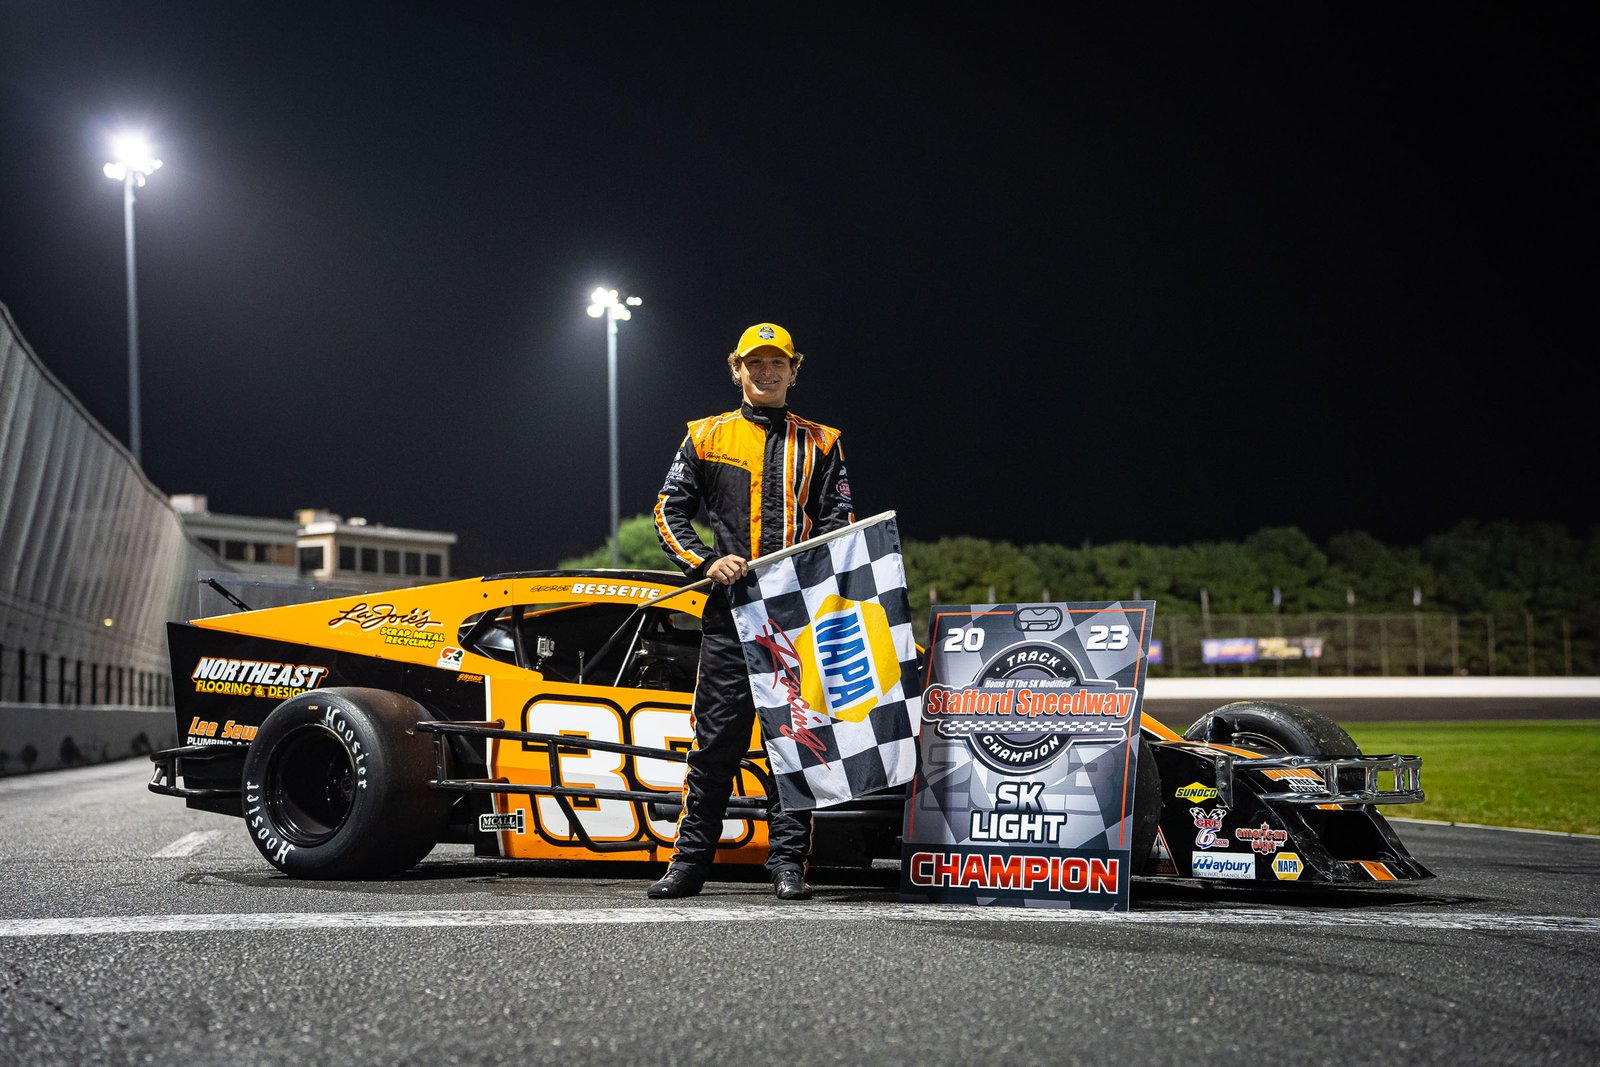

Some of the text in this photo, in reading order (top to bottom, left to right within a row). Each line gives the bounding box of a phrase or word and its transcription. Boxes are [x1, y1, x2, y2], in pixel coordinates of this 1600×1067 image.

[571, 583, 661, 600] BESSETTE
[380, 627, 412, 638] SCRAP
[413, 630, 446, 643] METAL
[384, 636, 436, 649] RECYCLING
[943, 627, 986, 652] 20
[1086, 624, 1130, 651] 23
[815, 612, 875, 709] NAPA
[1006, 650, 1062, 668] TRACK
[193, 657, 325, 690] NORTHEAST
[984, 679, 1071, 688] Home Of The SK Modified
[196, 679, 311, 699] FLOORING & DESIG
[927, 688, 1132, 718] Stafford Speedway
[188, 716, 218, 737] Lee
[323, 705, 369, 790] Hoosier
[982, 734, 1060, 763] CHAMPION
[997, 783, 1043, 812] SK
[1176, 787, 1218, 799] SUNOCO
[246, 780, 296, 865] Hoosier
[971, 812, 1066, 842] LIGHT
[1236, 829, 1287, 840] american
[910, 851, 1120, 895] CHAMPION
[1192, 857, 1252, 874] Maybury
[1277, 860, 1298, 873] NAPA
